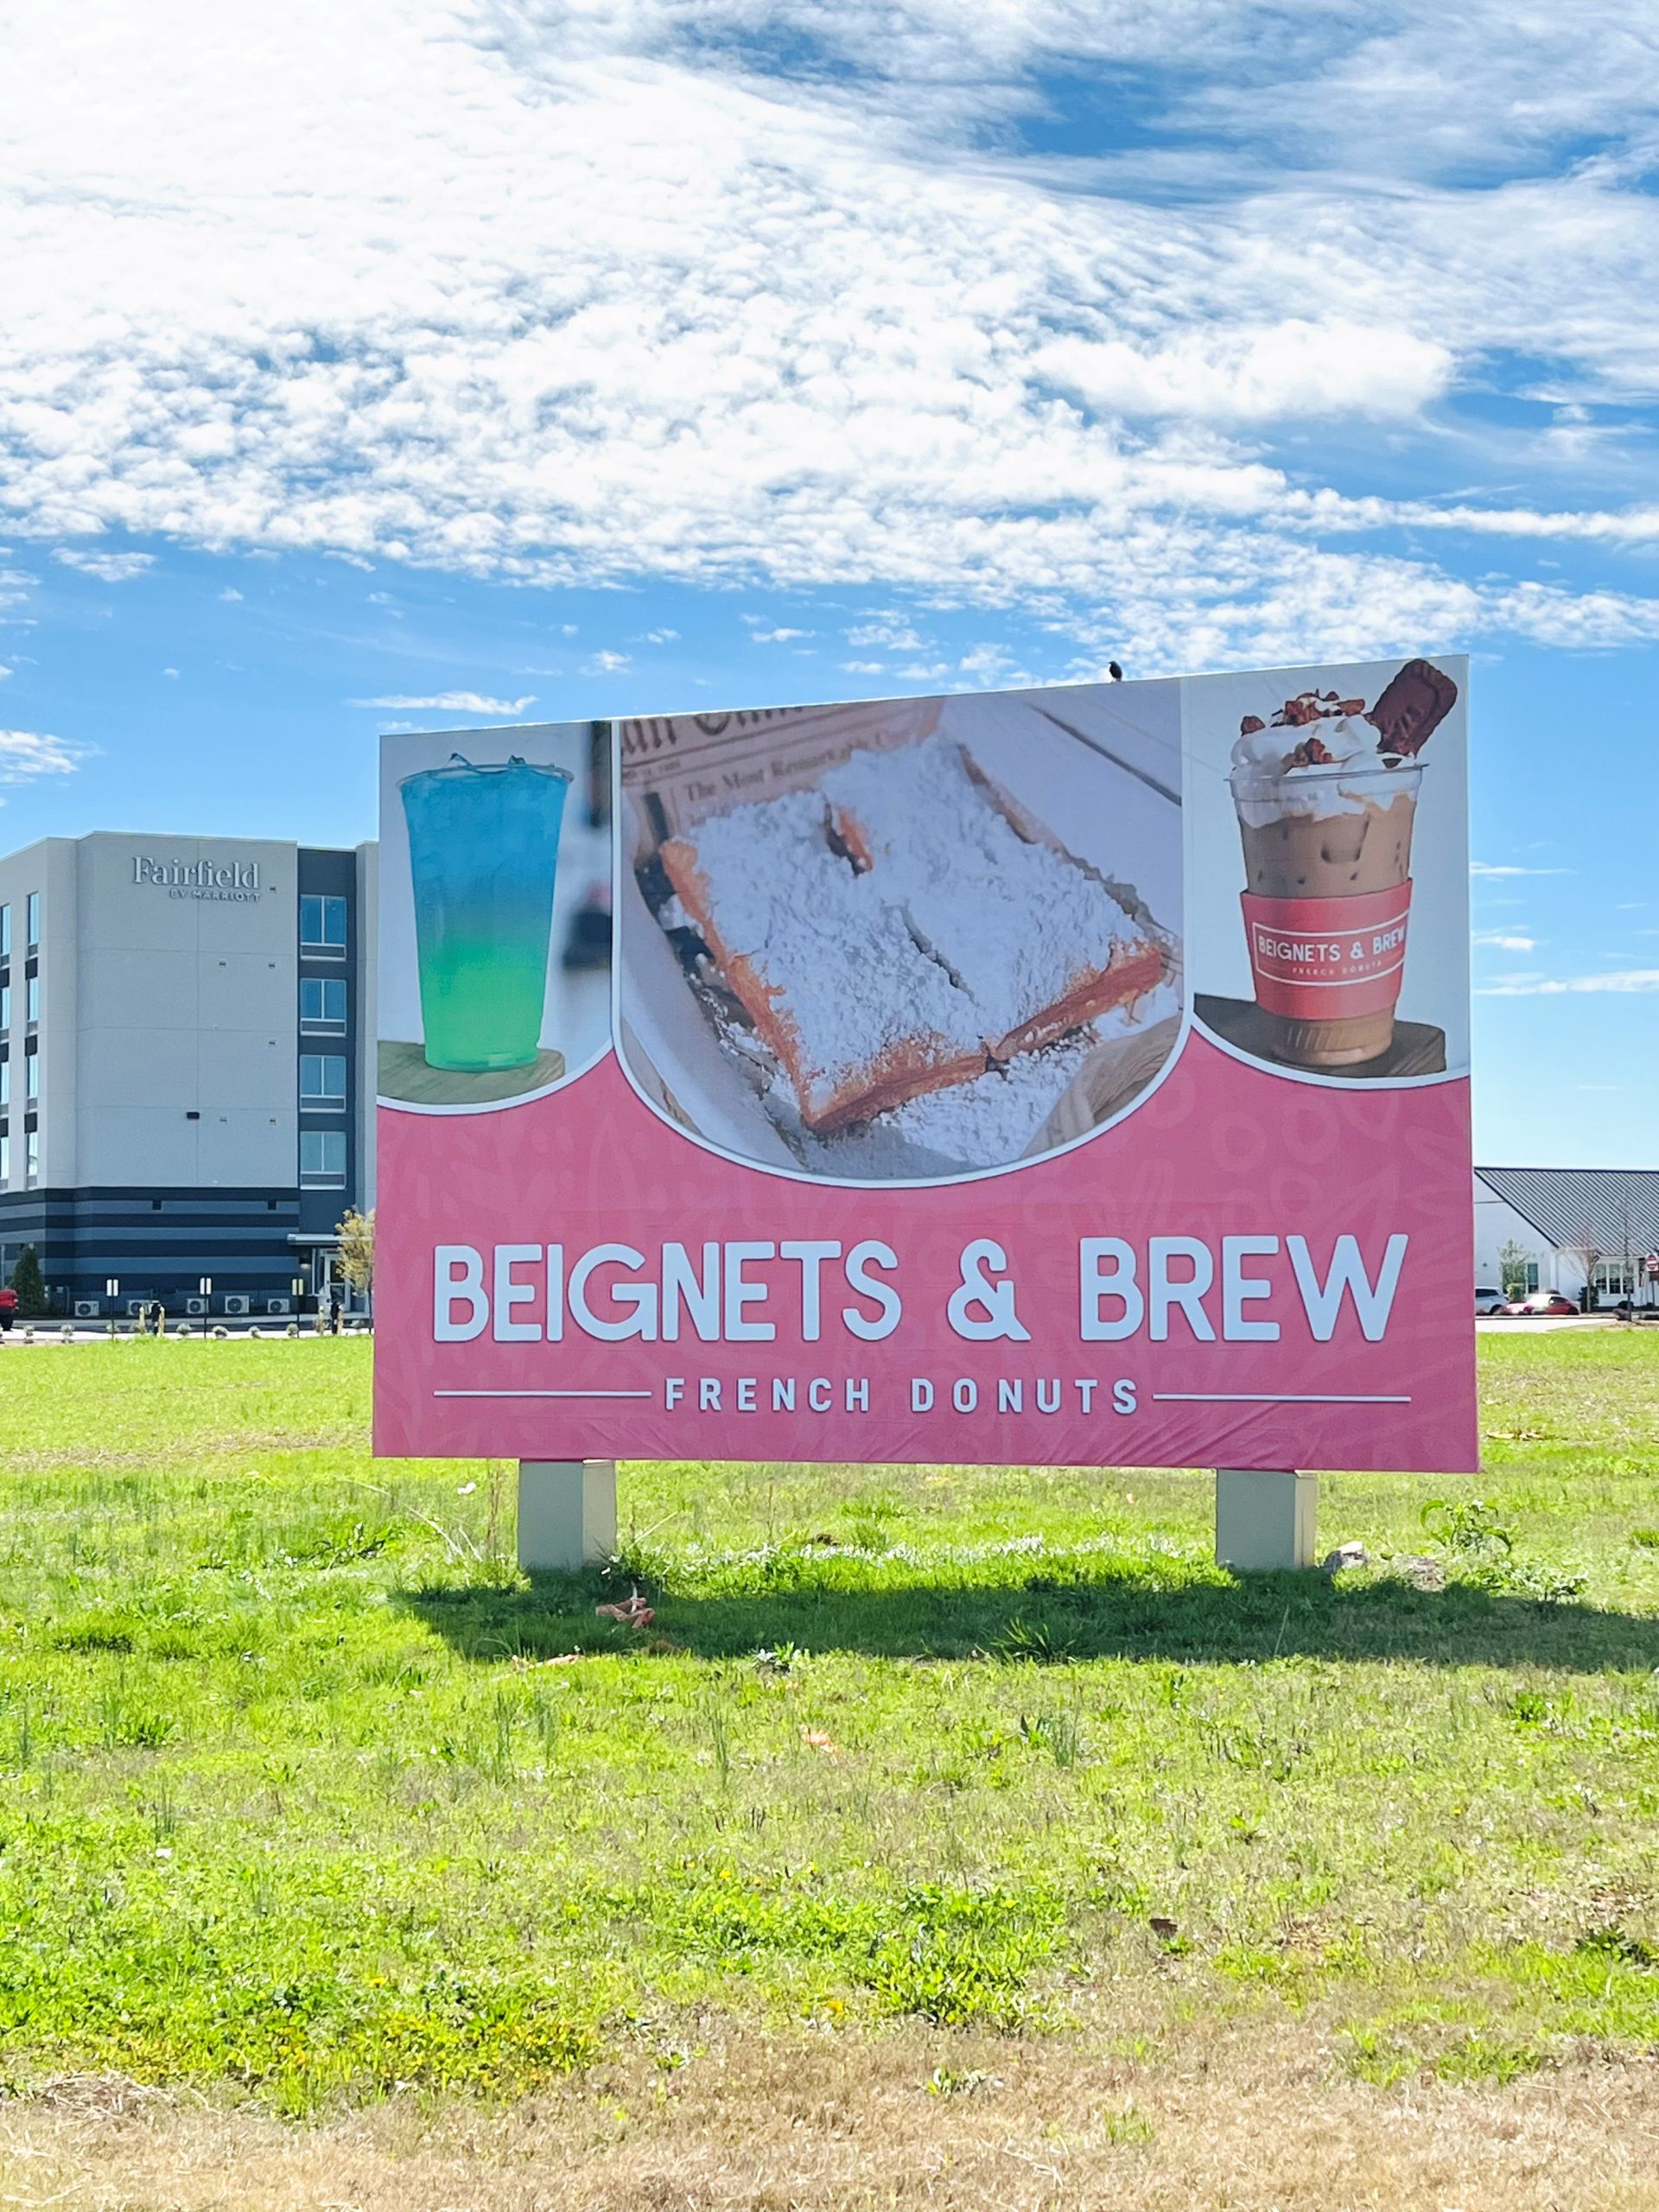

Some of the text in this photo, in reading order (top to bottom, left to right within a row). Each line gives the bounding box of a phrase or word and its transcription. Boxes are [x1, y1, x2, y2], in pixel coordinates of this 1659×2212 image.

[132, 855, 259, 889] Fairfield
[169, 888, 261, 902] BY MARRIOTT
[1258, 934, 1341, 962] BEIGNETS
[1350, 941, 1365, 959] &
[434, 1233, 1409, 1342] BEIGNETS & BREW
[665, 1377, 1138, 1414] FRENCH DONUTS
